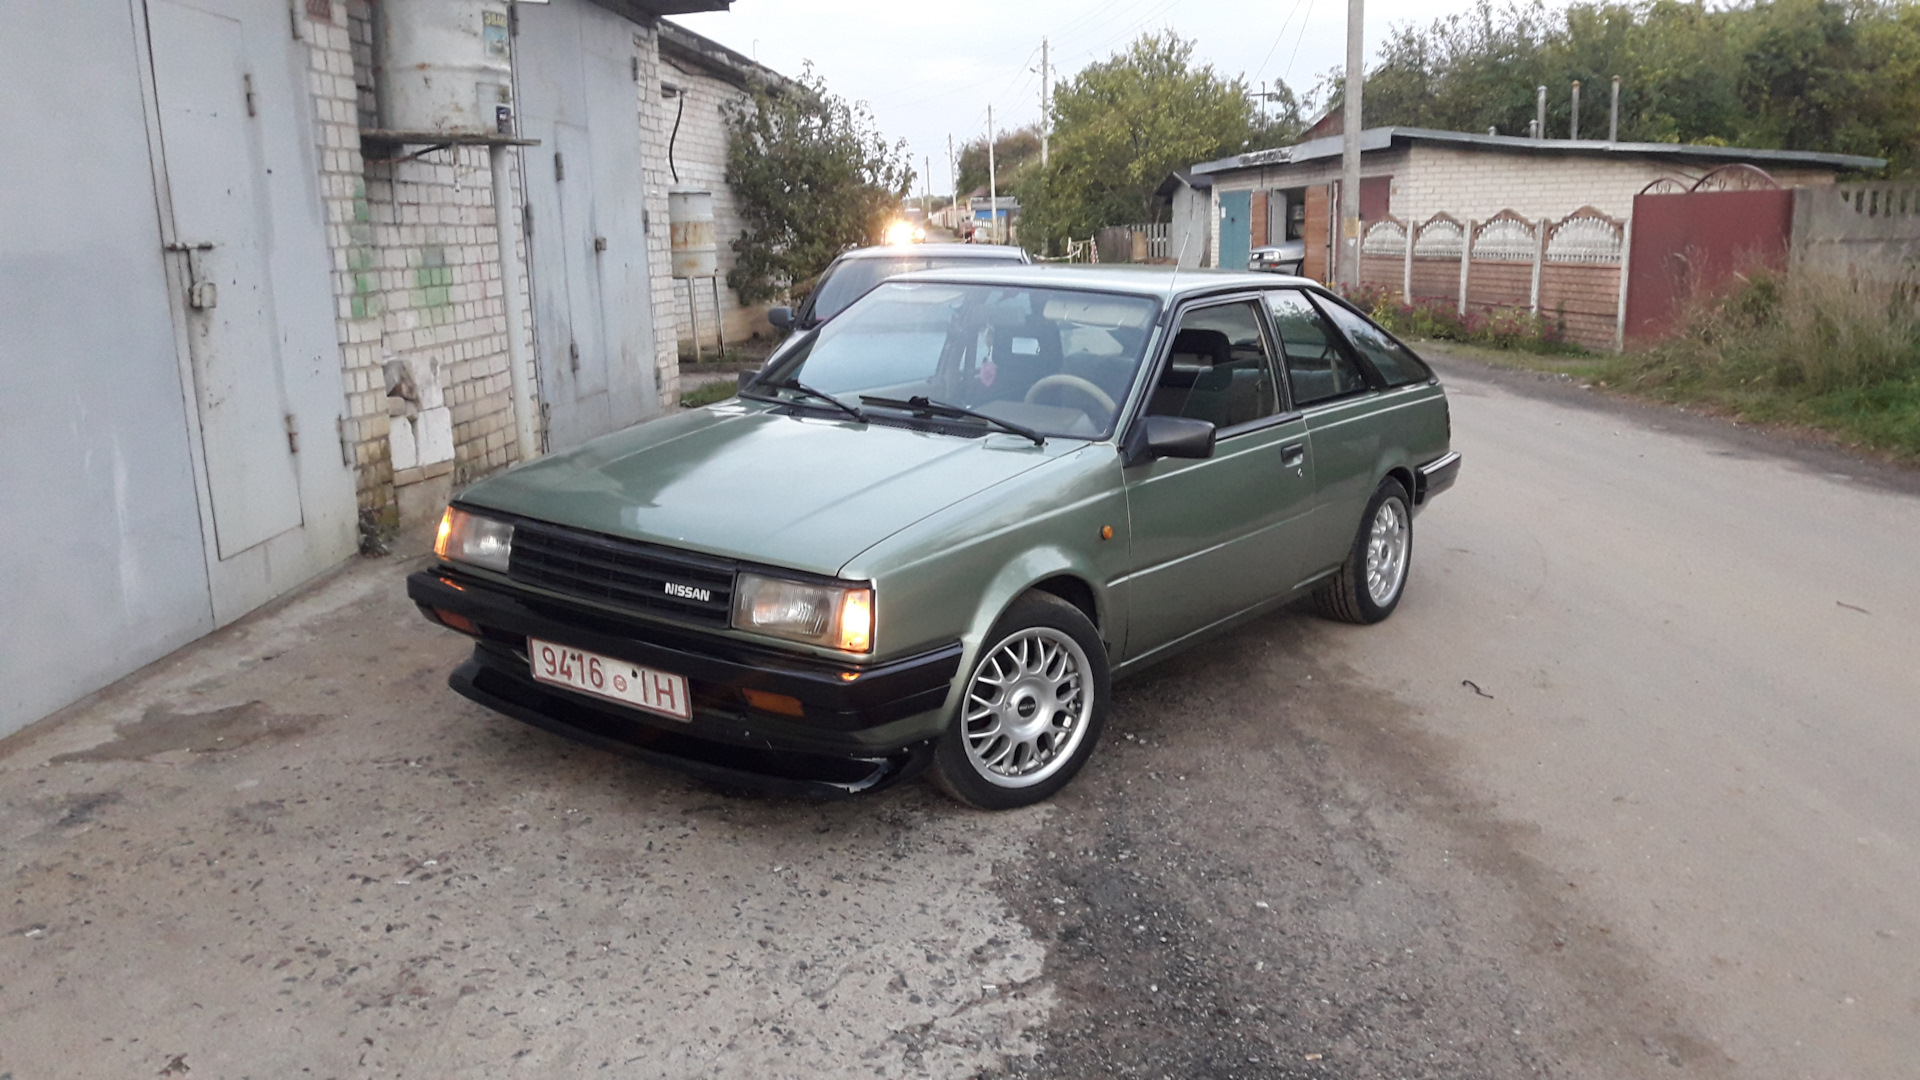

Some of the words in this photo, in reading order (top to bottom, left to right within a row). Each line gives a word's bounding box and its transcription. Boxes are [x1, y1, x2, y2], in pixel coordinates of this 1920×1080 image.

[664, 582, 710, 602] NISSAN
[542, 646, 604, 689] 9416
[641, 670, 677, 710] IH
